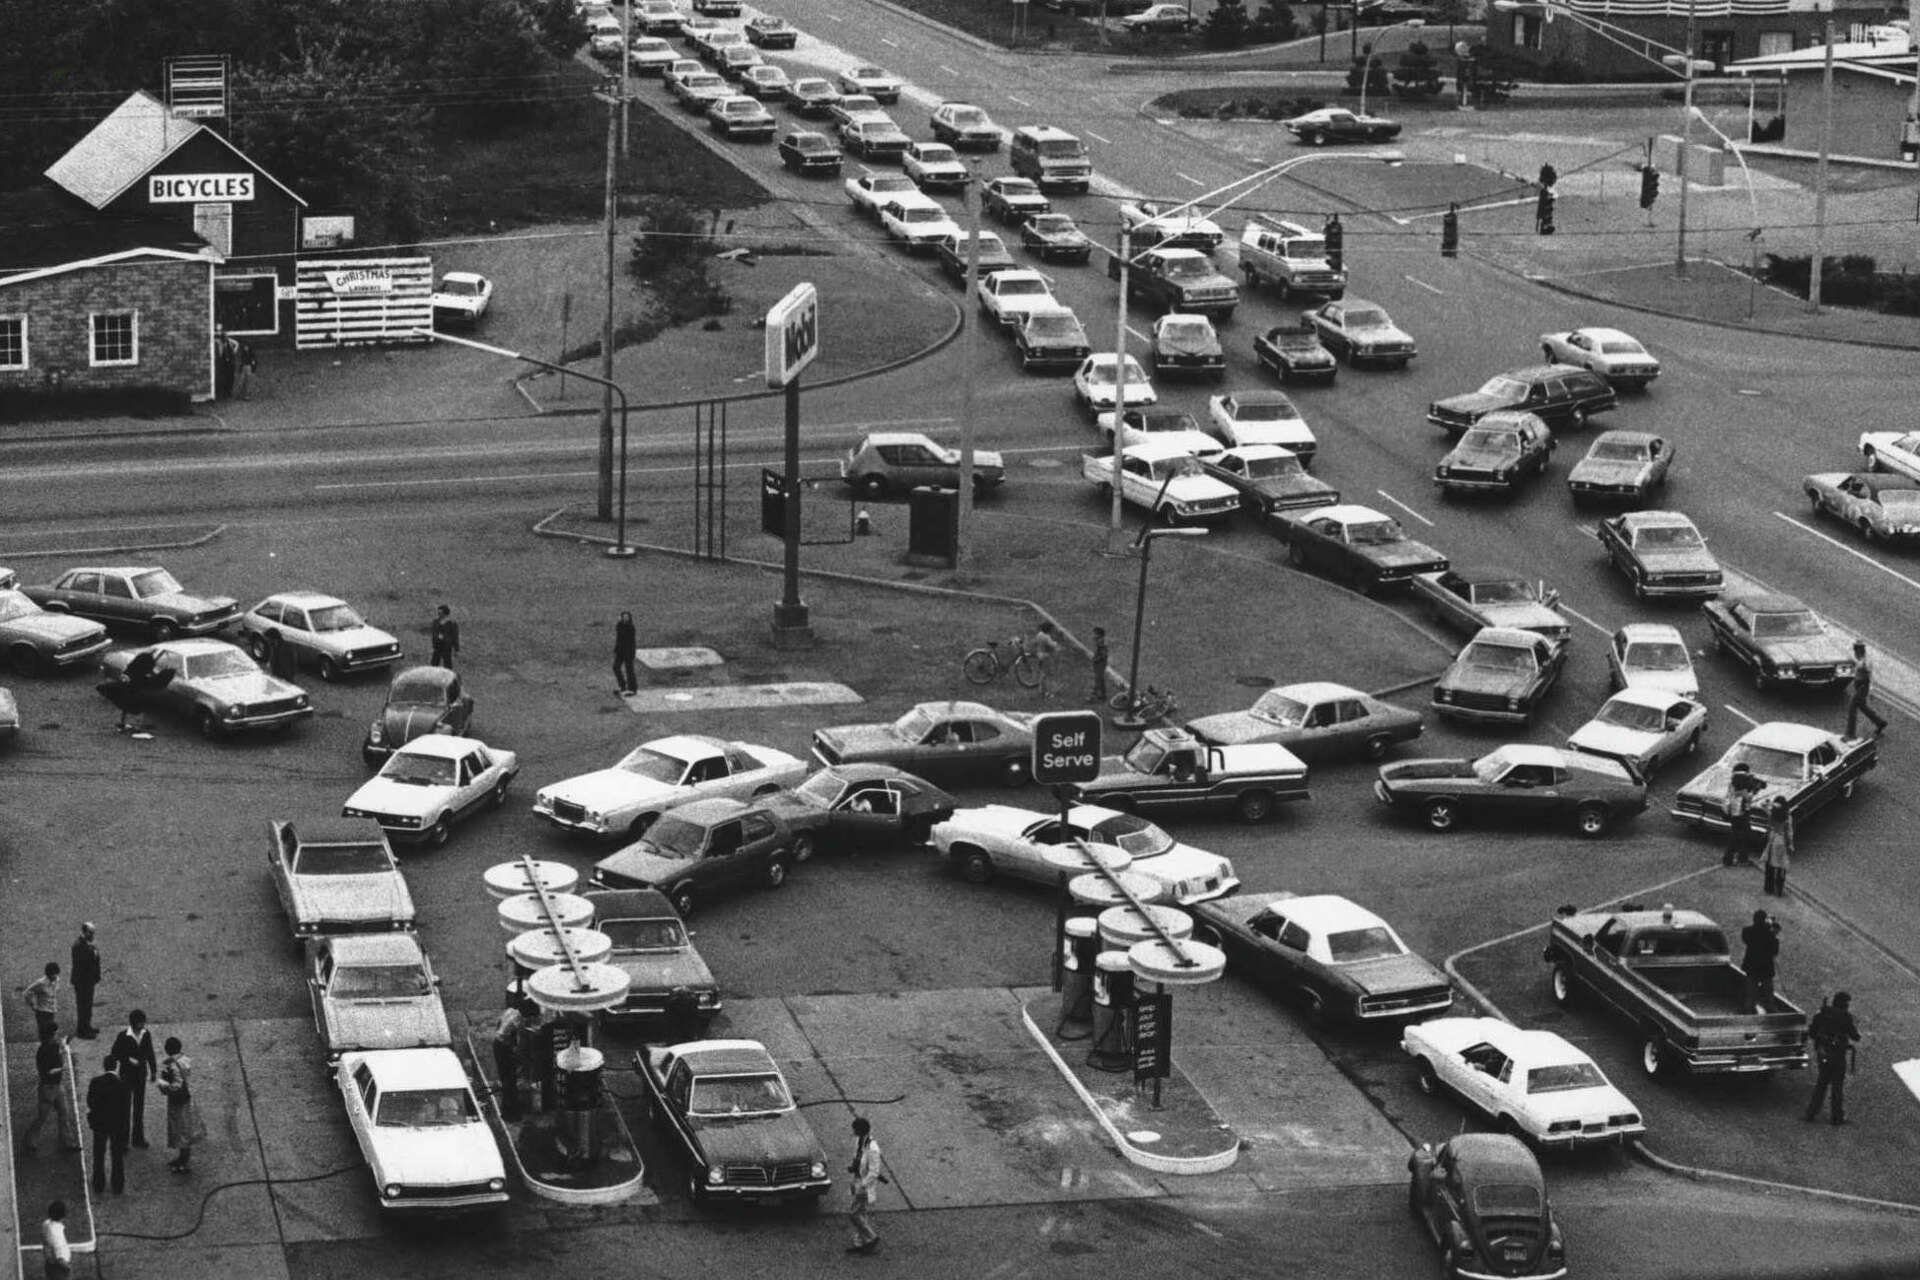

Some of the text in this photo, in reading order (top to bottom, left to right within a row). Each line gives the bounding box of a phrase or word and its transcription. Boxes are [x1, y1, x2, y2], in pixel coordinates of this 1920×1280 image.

[154, 178, 249, 197] BICYCLES
[336, 269, 390, 287] CHRISTMAS
[785, 301, 815, 359] Mobil
[1051, 731, 1086, 748] Self
[1043, 753, 1094, 768] Serve
